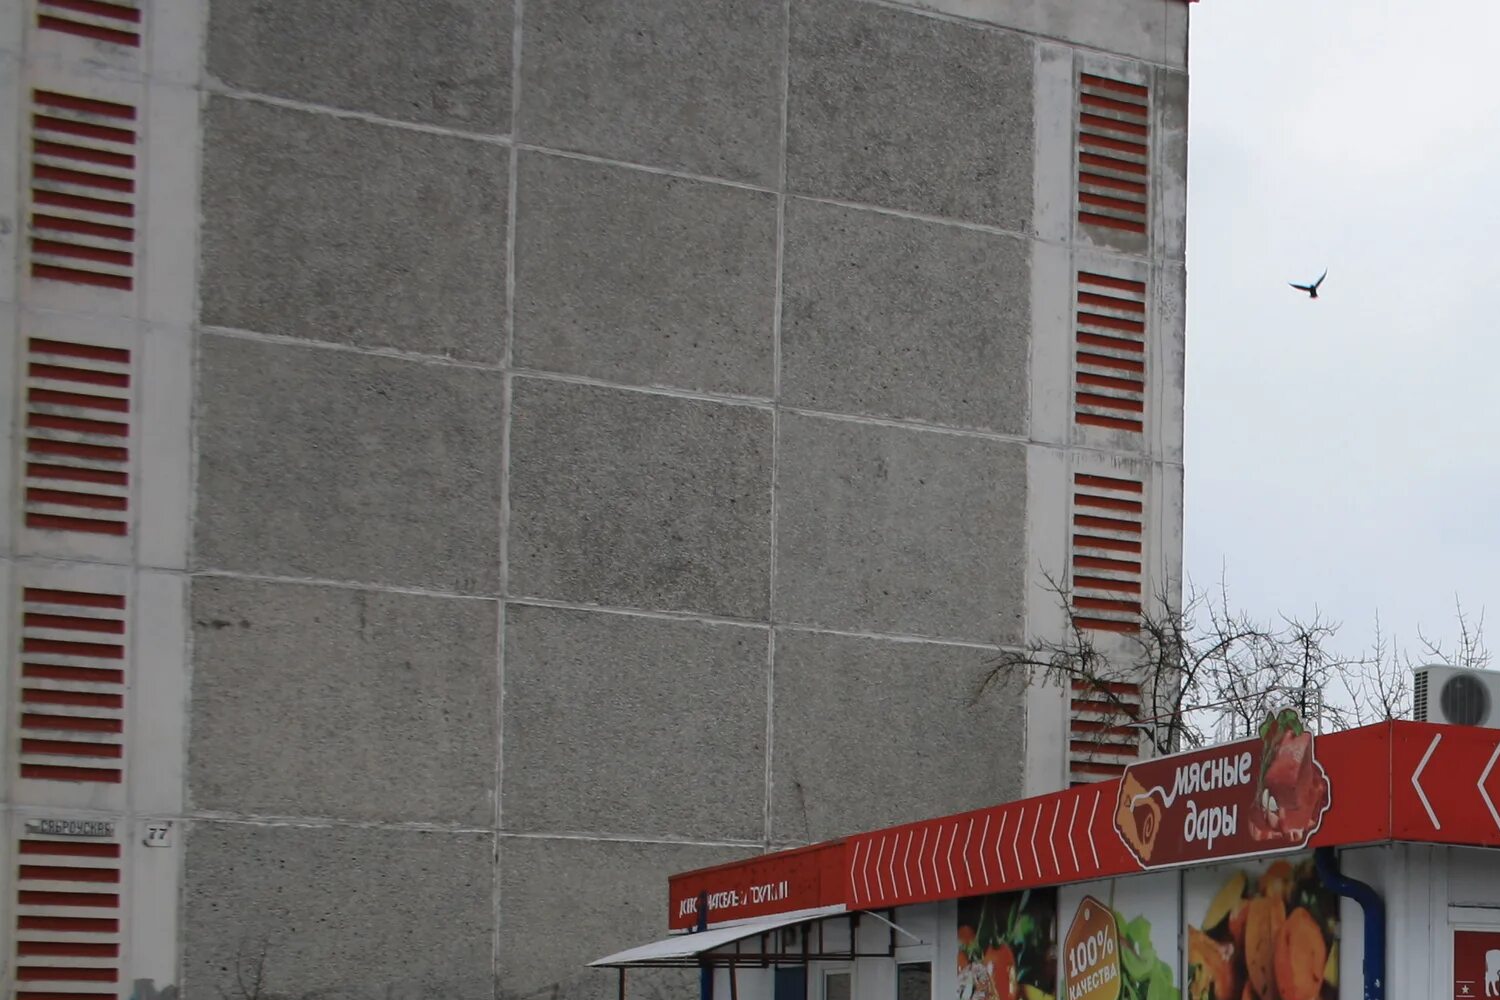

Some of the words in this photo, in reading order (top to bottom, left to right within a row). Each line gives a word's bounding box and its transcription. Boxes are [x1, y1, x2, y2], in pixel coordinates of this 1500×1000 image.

[1172, 752, 1252, 796] мясные
[149, 827, 168, 840] 77
[1184, 800, 1238, 850] дары
[1069, 925, 1114, 978] 100%
